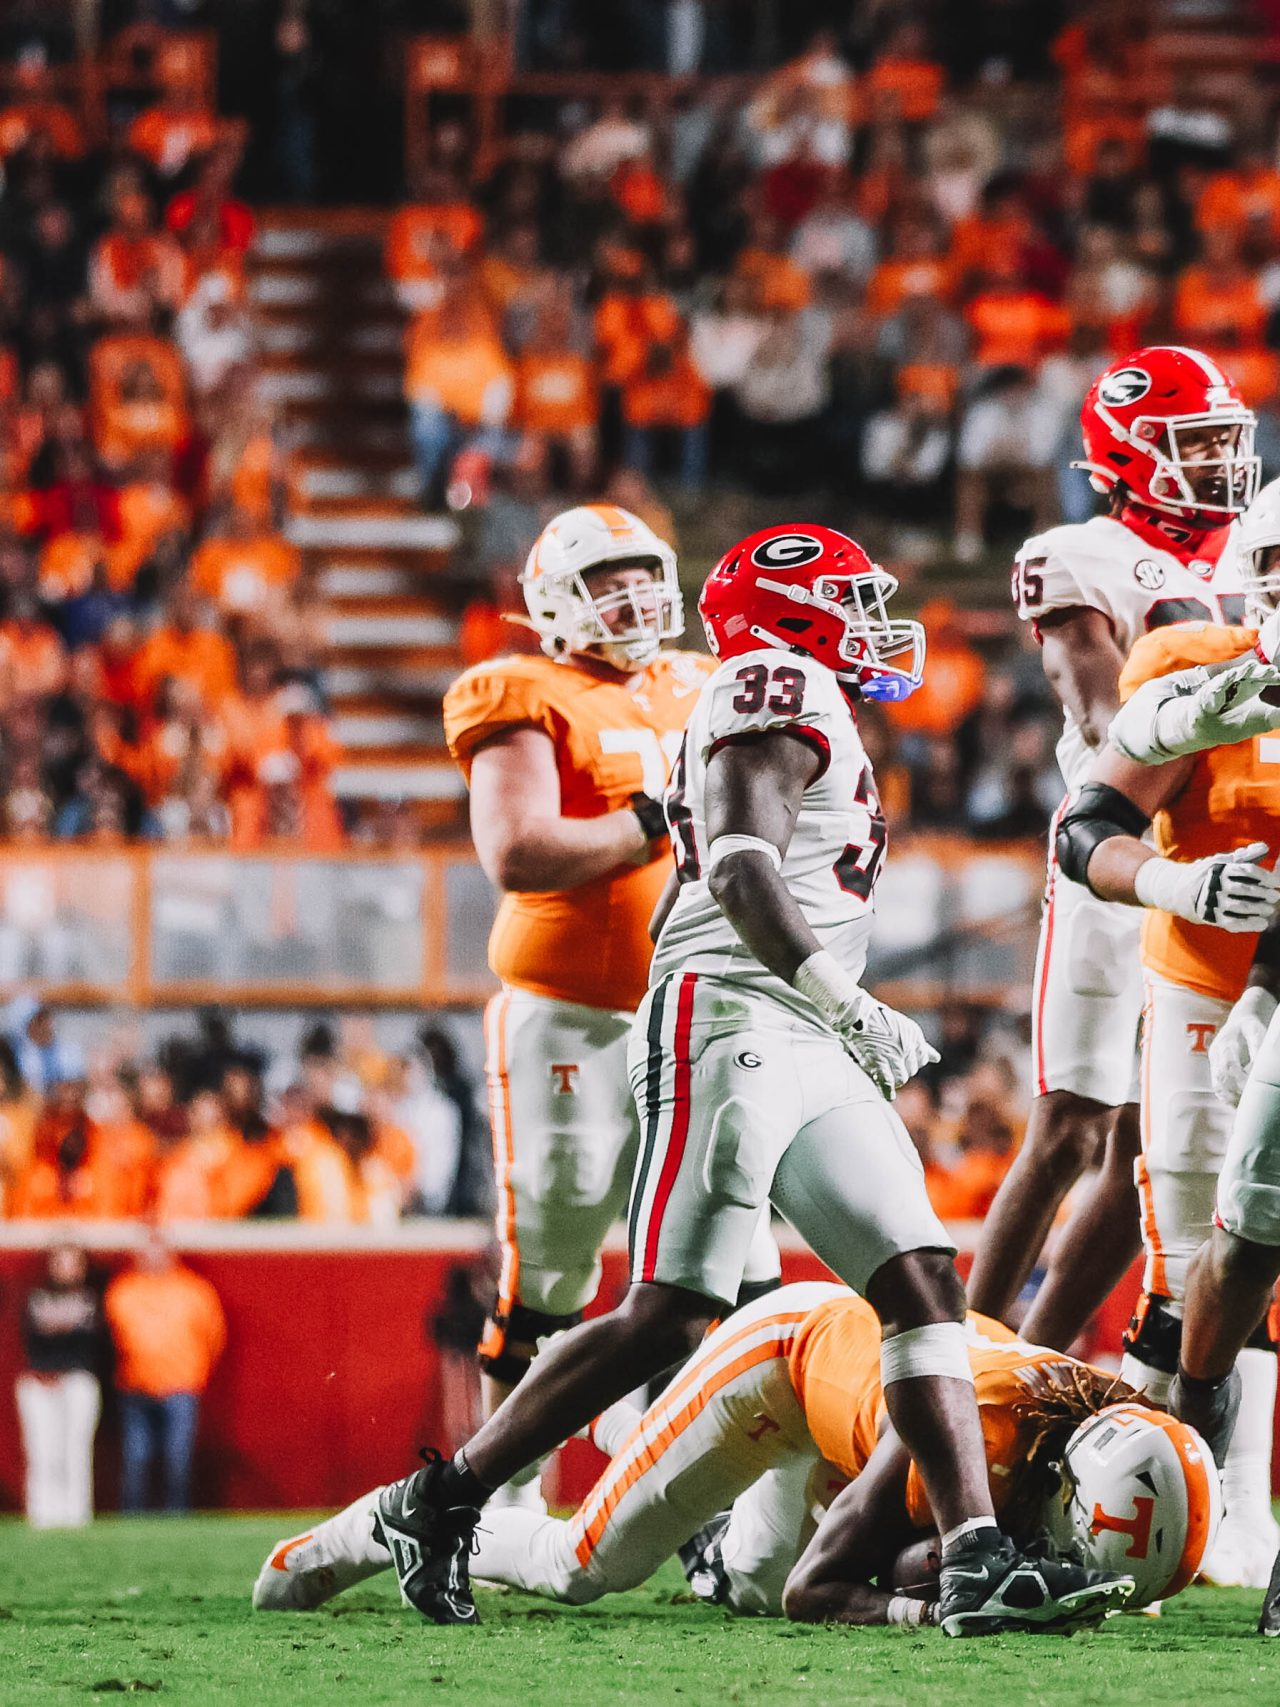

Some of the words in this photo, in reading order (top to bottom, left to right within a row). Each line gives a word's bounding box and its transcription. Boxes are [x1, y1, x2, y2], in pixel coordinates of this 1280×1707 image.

[757, 535, 823, 567] G
[733, 664, 807, 716] 33
[598, 729, 684, 804] 7
[1186, 1023, 1217, 1054] T
[736, 1050, 763, 1071] G
[551, 1064, 579, 1094] T
[747, 1411, 781, 1442] T
[1089, 1495, 1155, 1560] T
